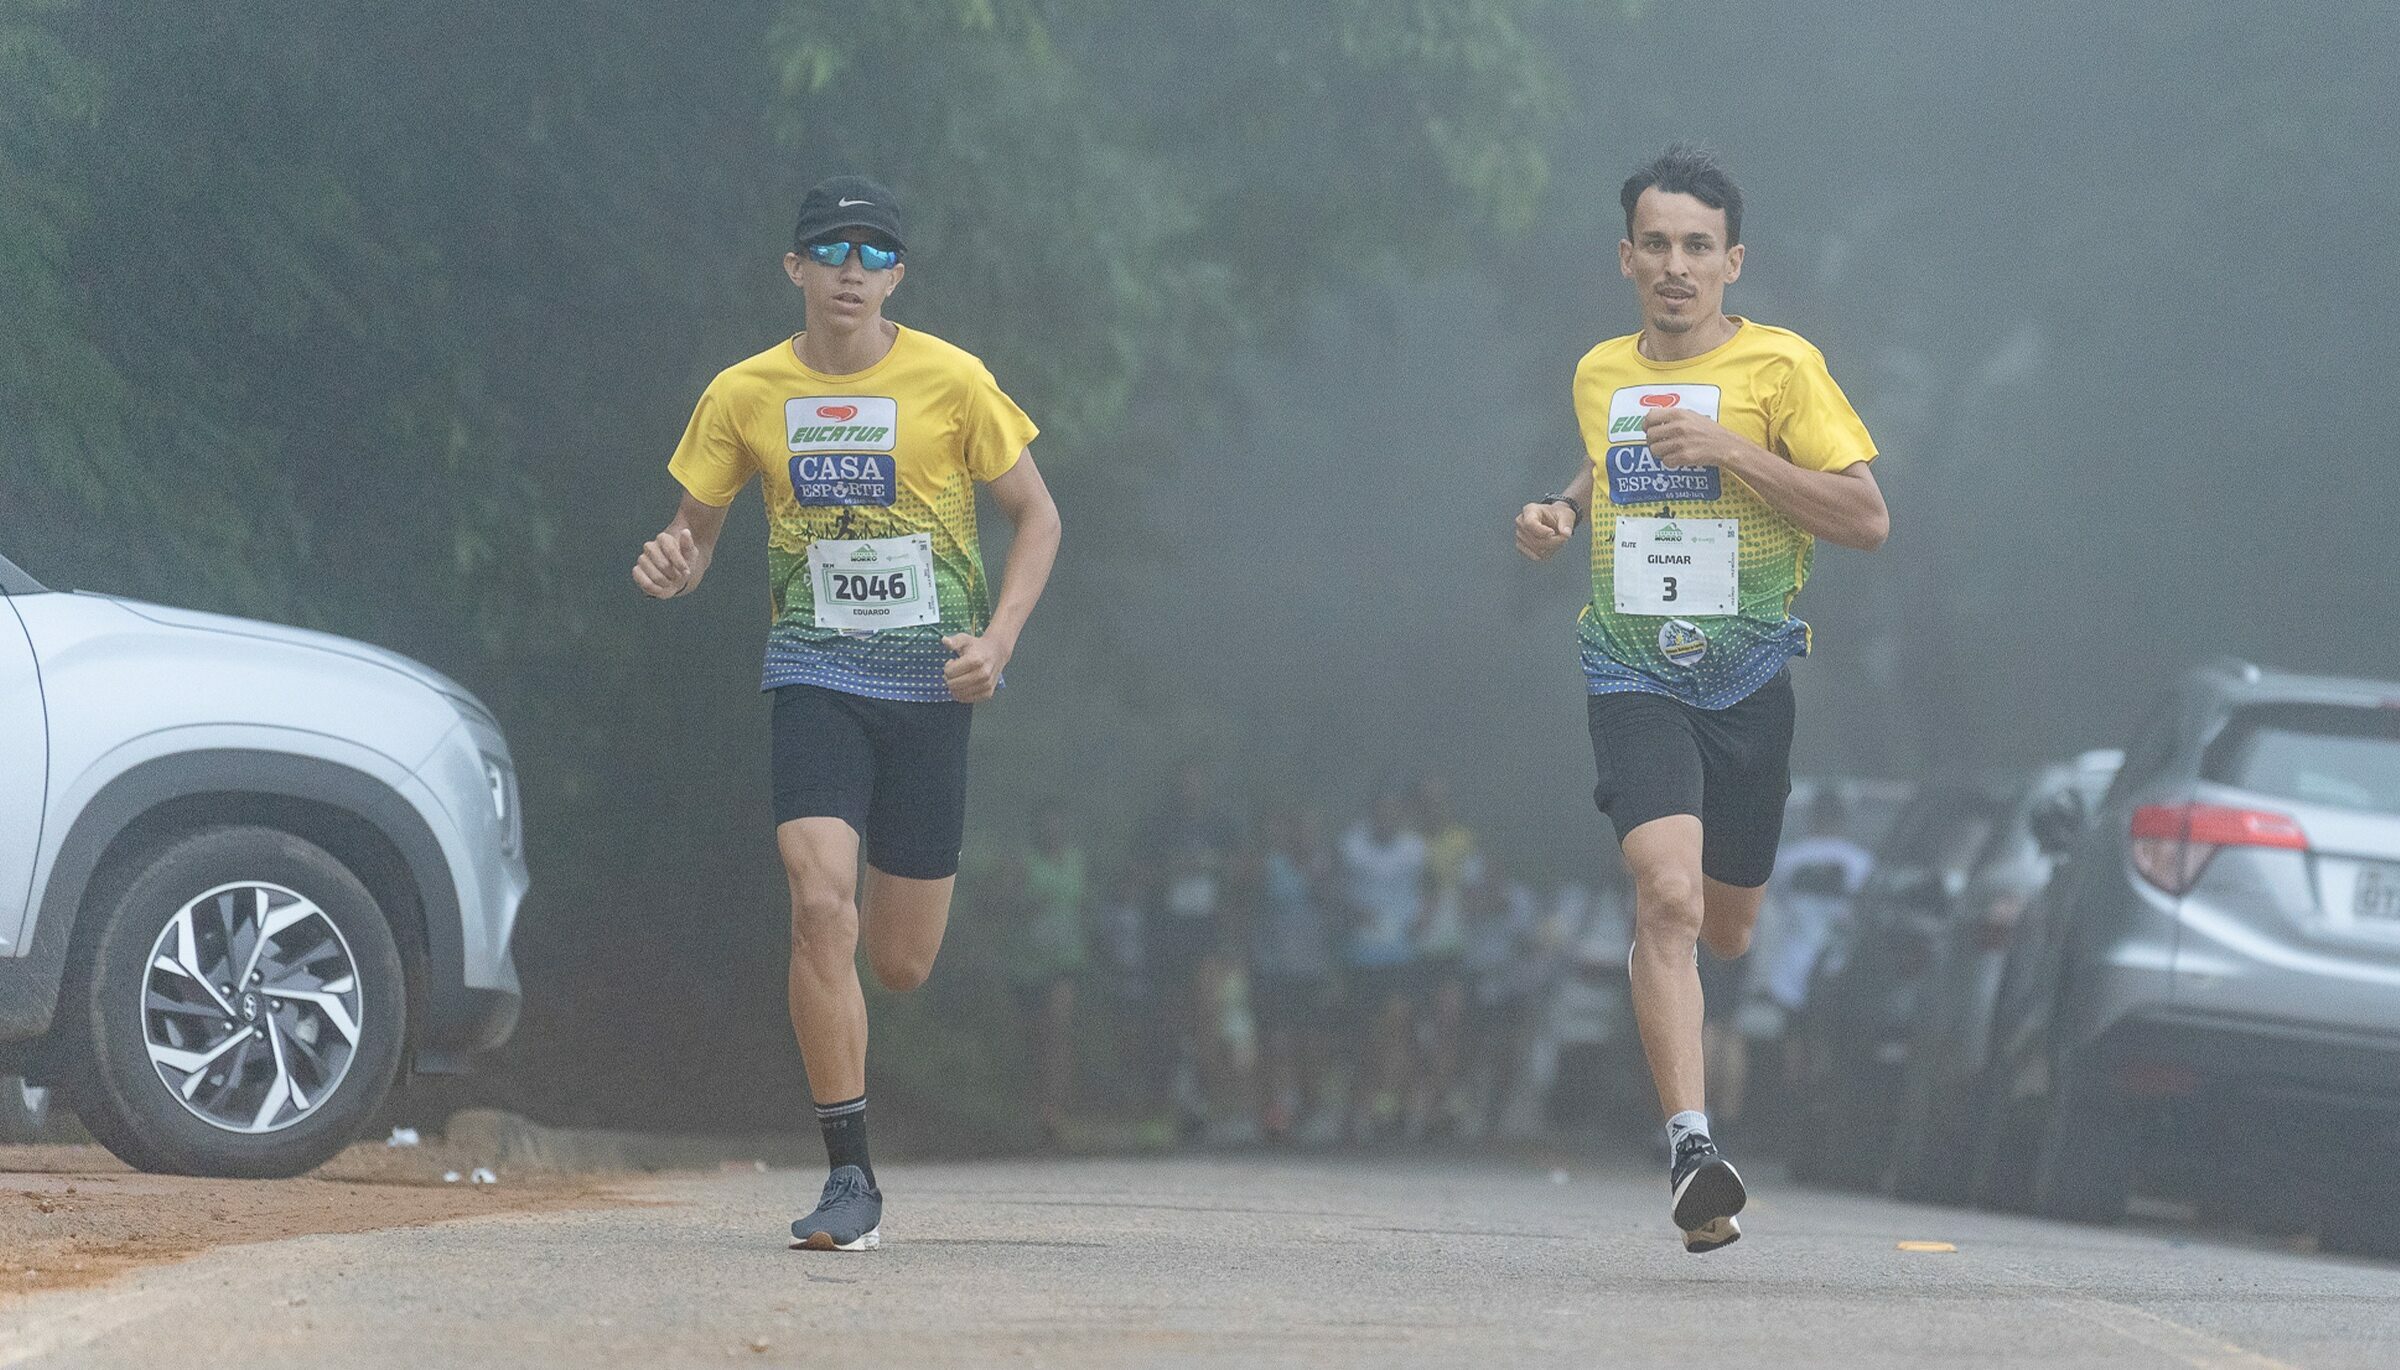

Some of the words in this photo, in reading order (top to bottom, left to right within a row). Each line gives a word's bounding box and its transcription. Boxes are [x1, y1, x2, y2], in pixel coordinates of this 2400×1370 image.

[791, 426, 889, 443] EUCATUR
[799, 457, 884, 480] CASA
[1615, 447, 1707, 474] CA
[800, 481, 885, 498] ESPORTE
[1617, 474, 1709, 493] ESPORTE
[1647, 554, 1692, 565] GILMAR
[833, 573, 906, 600] 2046
[1662, 576, 1678, 602] 3
[853, 608, 890, 616] EDUARDO
